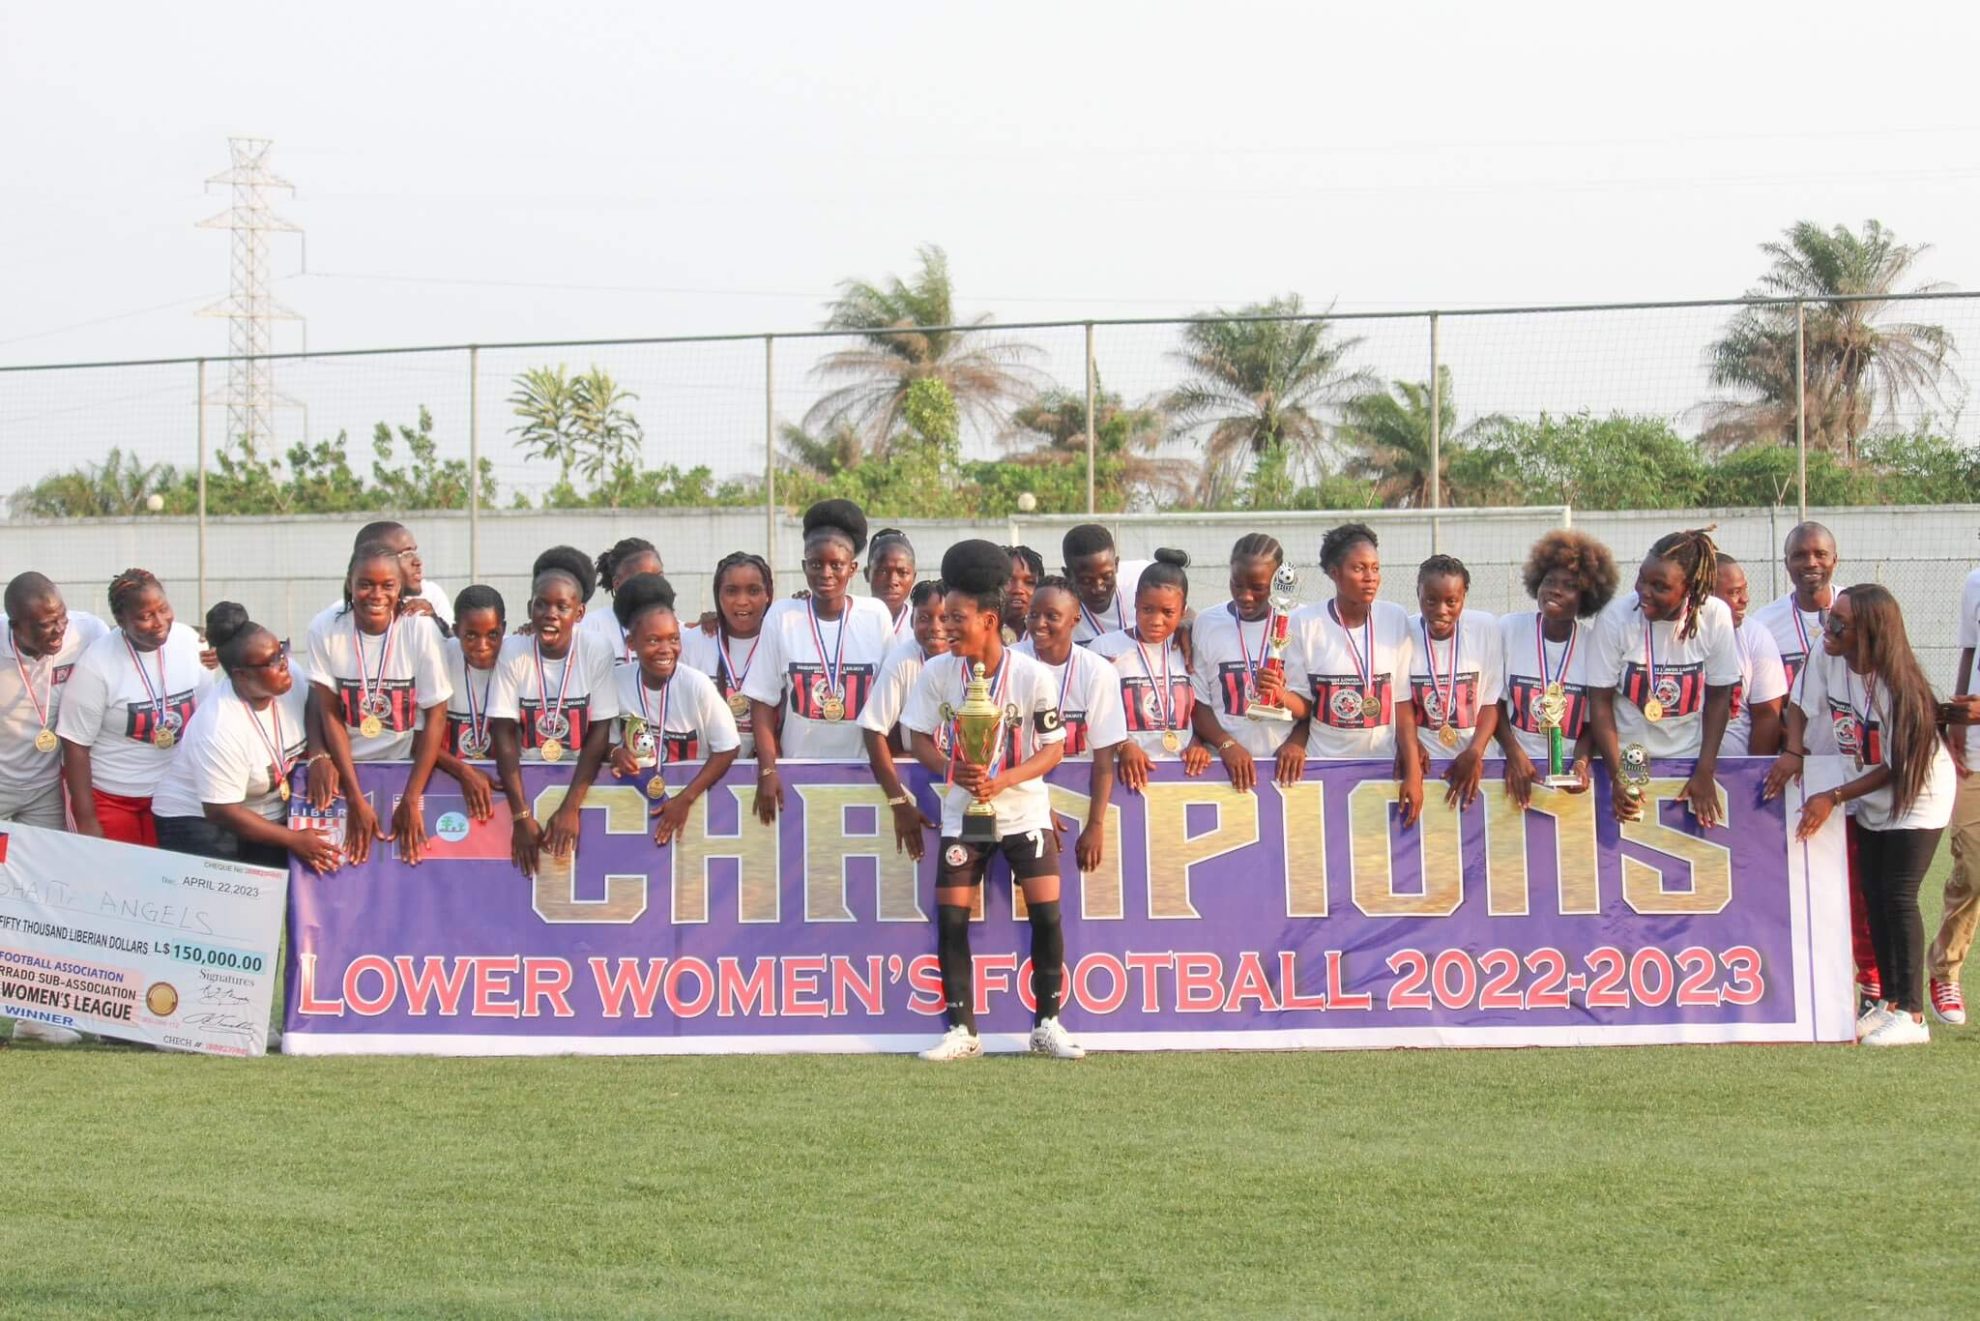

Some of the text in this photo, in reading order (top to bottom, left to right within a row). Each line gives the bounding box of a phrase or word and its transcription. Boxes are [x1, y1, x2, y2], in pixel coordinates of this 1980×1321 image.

[1043, 711, 1057, 729] C
[290, 807, 347, 817] LIBER
[1026, 829, 1045, 859] 7
[204, 861, 232, 872] CHEQUE
[182, 876, 215, 891] APRIL
[218, 882, 259, 898] 22,2023
[100, 890, 214, 936] ANGELS
[23, 919, 68, 941] THOUSAND
[69, 927, 107, 948] LIBERIAN
[109, 936, 148, 956] DOLLARS
[154, 942, 170, 956] L$
[173, 944, 262, 972] 150,000.00
[0, 951, 124, 983] FOOTBALL ASSOCIATION
[198, 968, 255, 988] Signatures
[299, 953, 574, 1018] LOWER
[588, 952, 947, 1017] WOMEN'S
[1386, 945, 1766, 1010] 2022-2023
[0, 965, 137, 1000] RRADO SUB-ASSOCIATION
[1, 981, 133, 1021] WOMEN'S LEAGUE
[4, 1004, 74, 1027] WINNER
